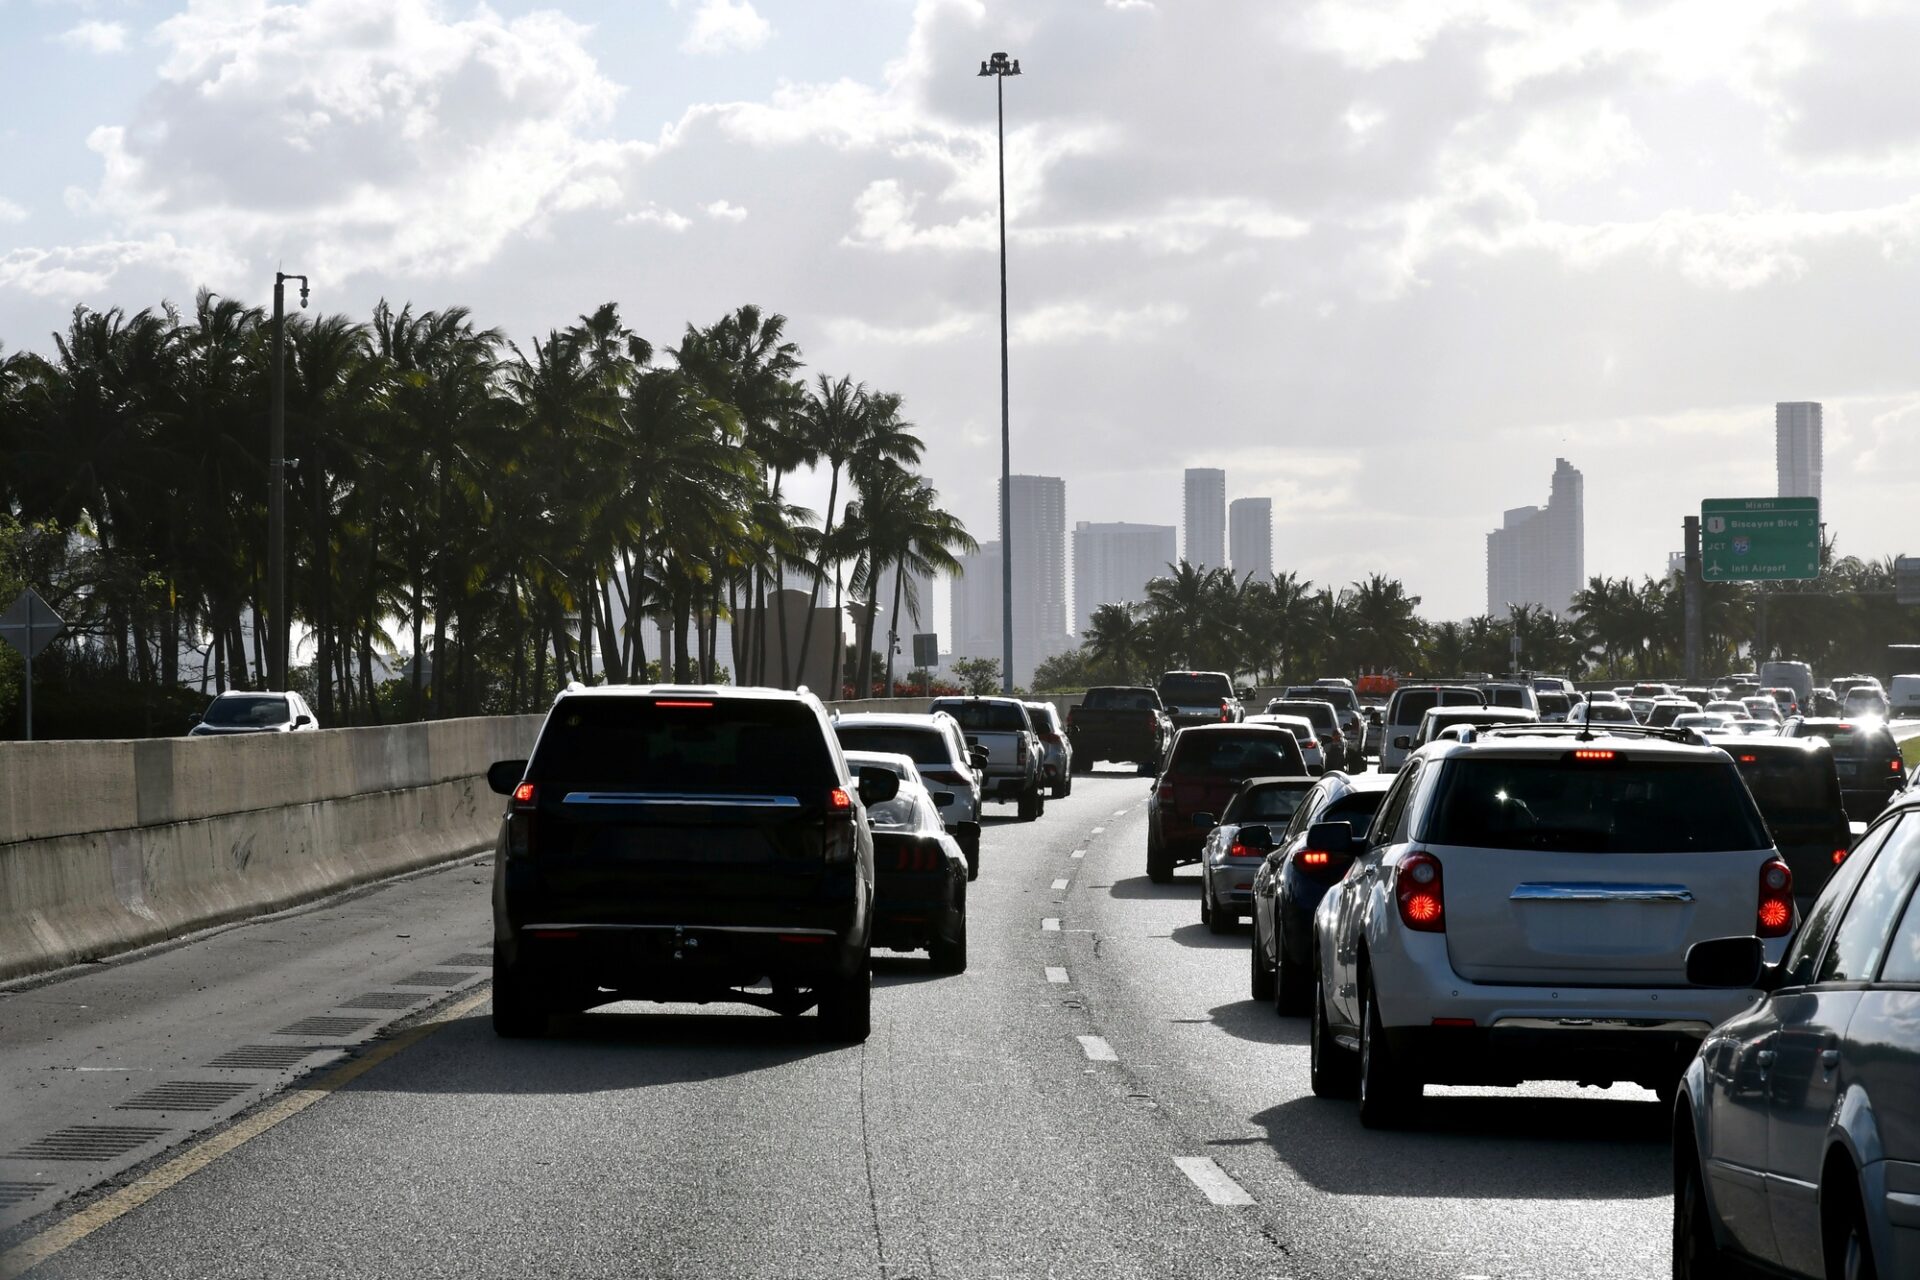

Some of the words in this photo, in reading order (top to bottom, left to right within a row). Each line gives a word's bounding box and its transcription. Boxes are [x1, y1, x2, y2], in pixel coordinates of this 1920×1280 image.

[1745, 501, 1775, 509] Miami
[1731, 520, 1774, 528] Biscayne
[1777, 518, 1799, 527] Blvd
[1707, 542, 1726, 551] JCT
[1734, 541, 1748, 552] 95
[1751, 564, 1786, 573] Airport
